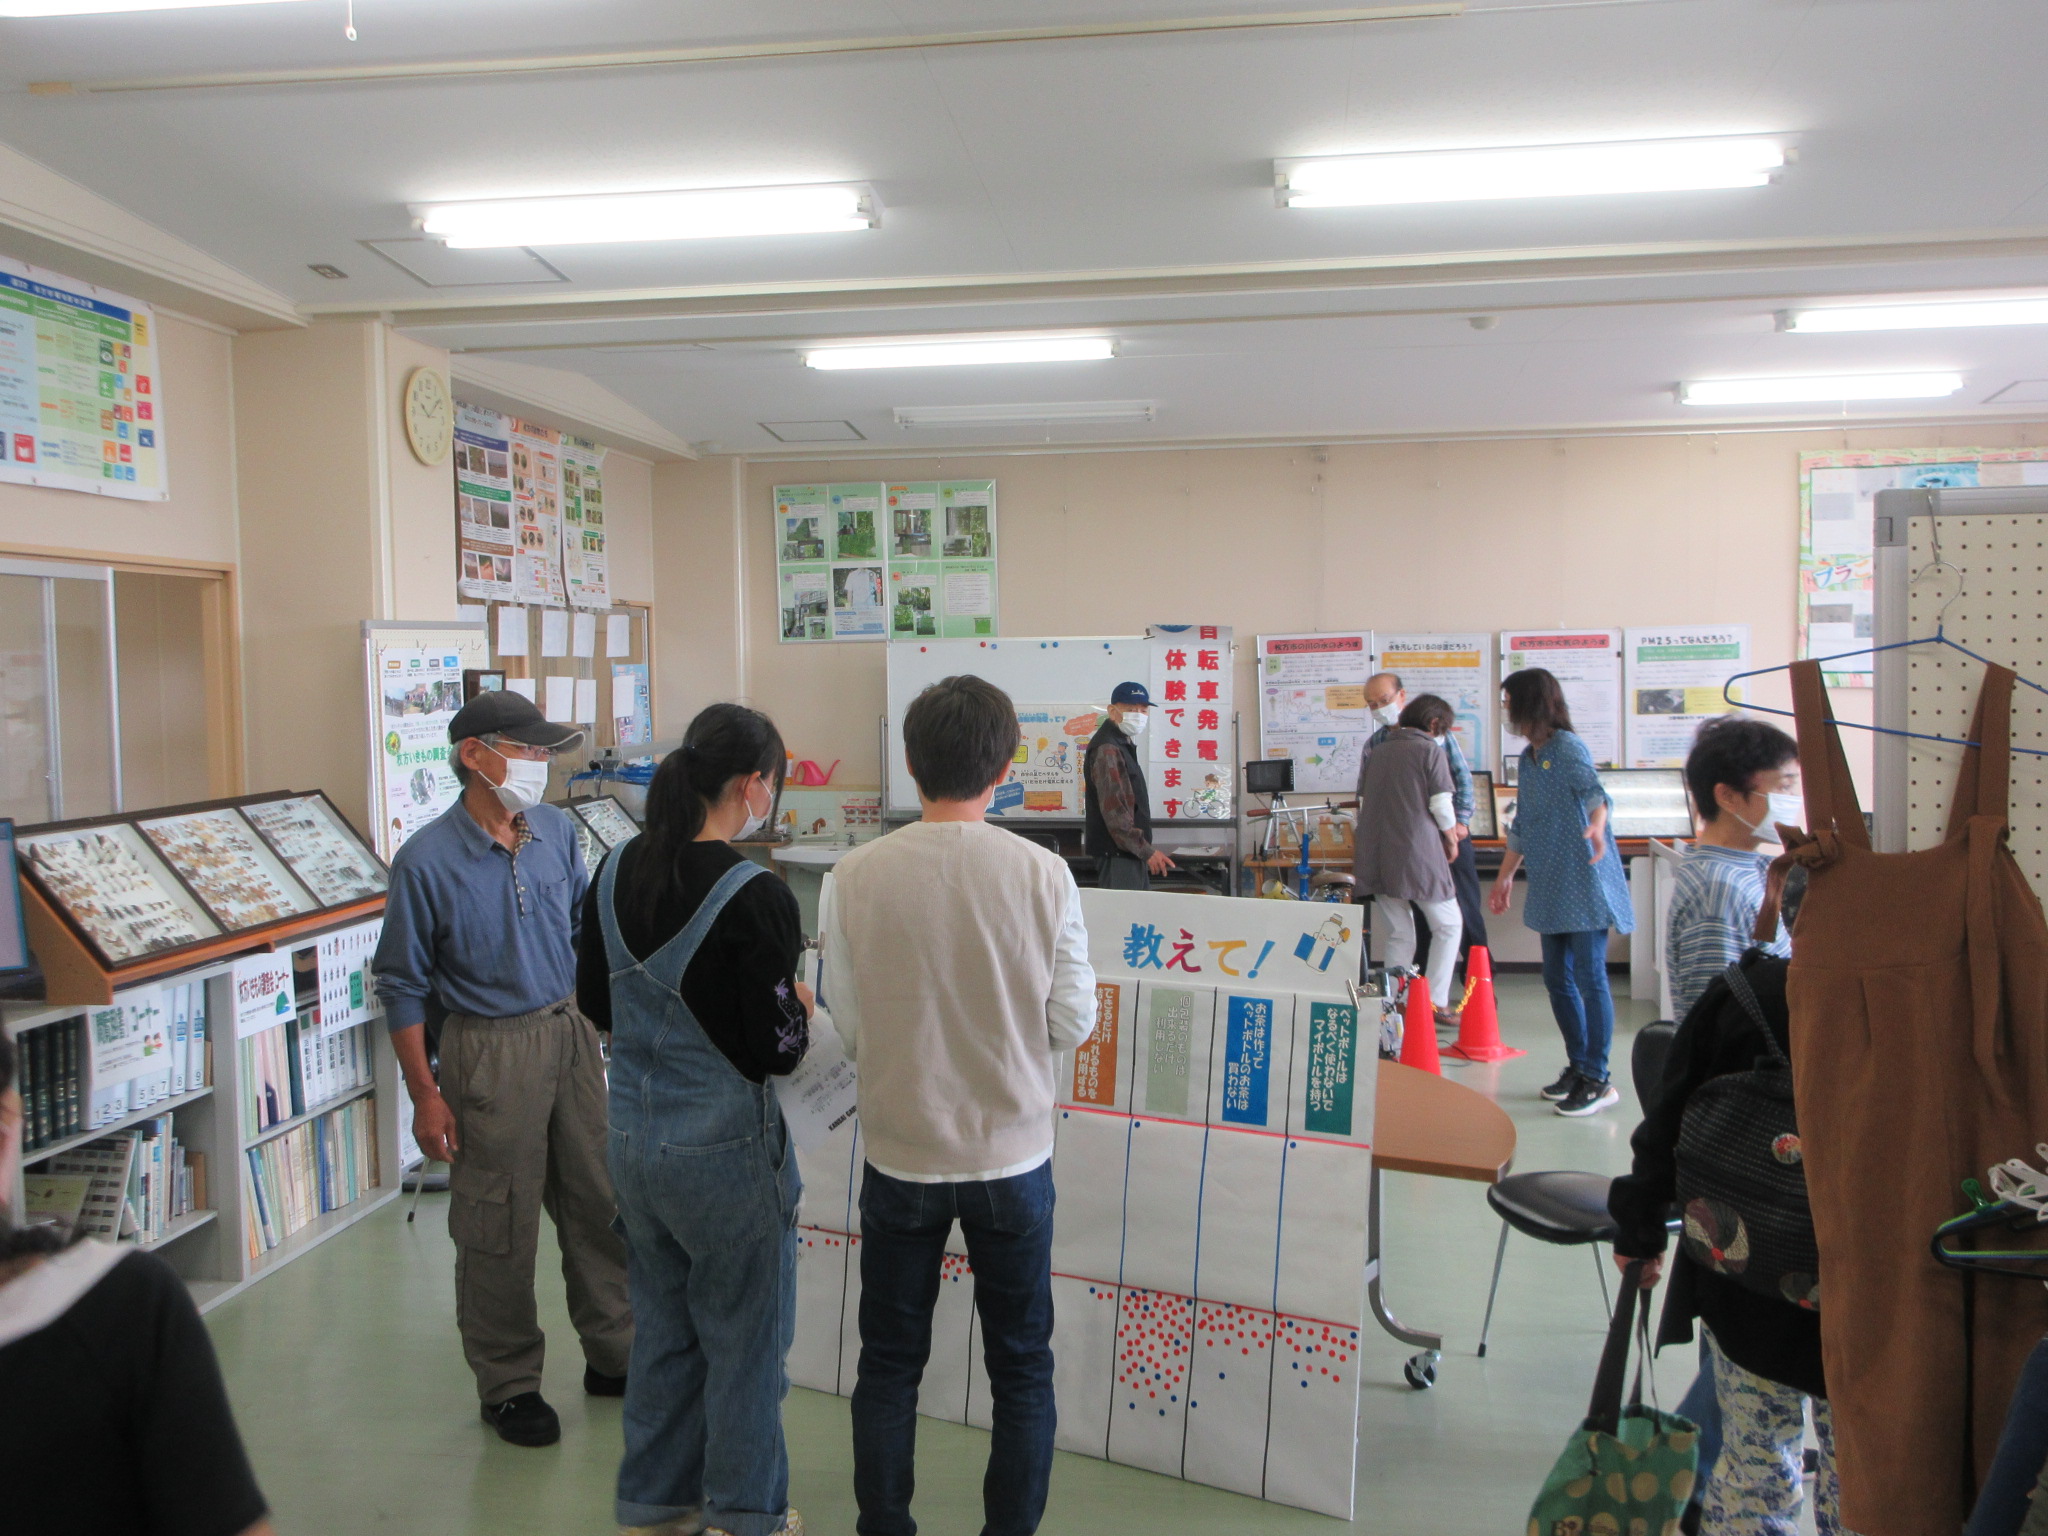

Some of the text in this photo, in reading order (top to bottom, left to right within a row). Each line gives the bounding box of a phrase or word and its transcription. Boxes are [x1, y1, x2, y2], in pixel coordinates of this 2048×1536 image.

[1197, 625, 1219, 761] 自転車発電
[1163, 649, 1187, 818] 体験できます
[1123, 923, 1275, 979] 教えて！
[1101, 987, 1114, 1043] できるだけ
[1153, 1017, 1167, 1074] 利用しない
[1165, 1006, 1179, 1064] 出来るだけ
[1252, 1003, 1267, 1069] お茶は作って
[1077, 1051, 1090, 1098] 利用する
[1309, 1019, 1326, 1112] マイボトルを持つ
[1322, 1008, 1338, 1111] なるべく使わないで
[1335, 1009, 1351, 1084] ペットボトルは
[1226, 1062, 1240, 1109] 買わない
